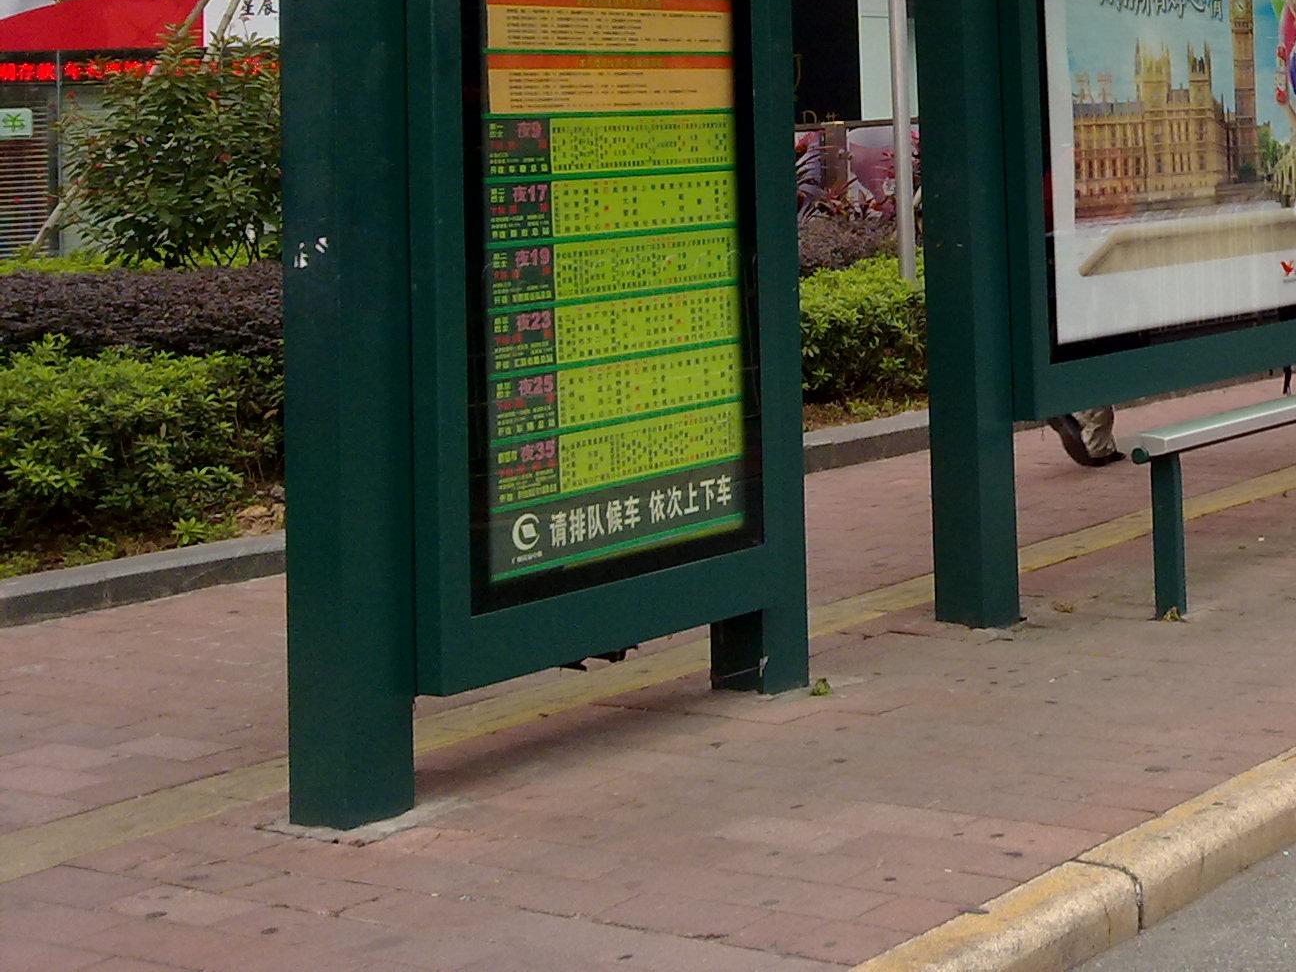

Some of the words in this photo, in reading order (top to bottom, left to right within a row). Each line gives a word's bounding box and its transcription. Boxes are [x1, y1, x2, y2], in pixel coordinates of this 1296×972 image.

[549, 495, 641, 548] 请排队候车
[648, 474, 732, 524] 依次上下车
